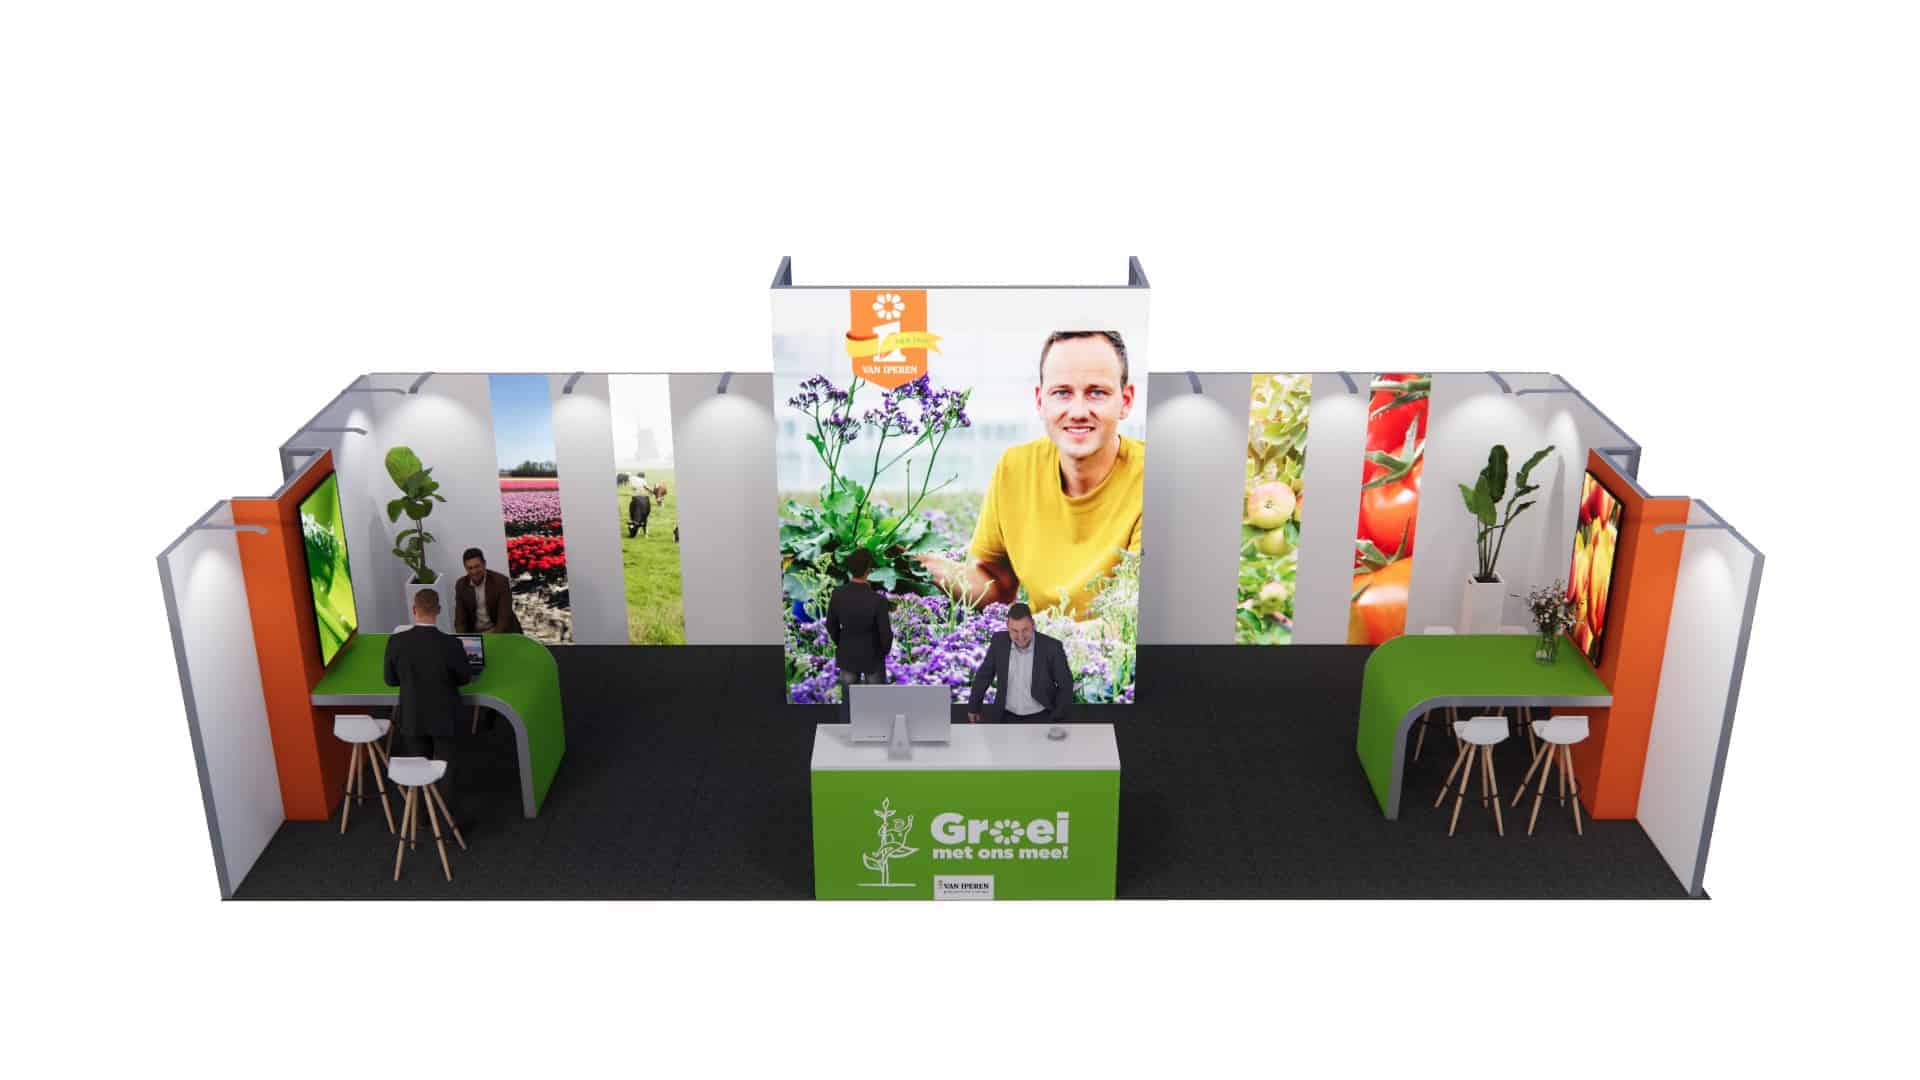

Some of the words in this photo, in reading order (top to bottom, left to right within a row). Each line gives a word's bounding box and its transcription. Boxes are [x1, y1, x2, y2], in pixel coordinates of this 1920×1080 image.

[862, 365, 881, 375] VAN
[884, 365, 918, 375] IPEREN
[930, 811, 1070, 845] Groei
[932, 846, 973, 859] met
[978, 848, 1014, 859] ons
[1019, 846, 1069, 859] mee!
[943, 882, 959, 890] VAN
[961, 882, 990, 890] IPEREN
